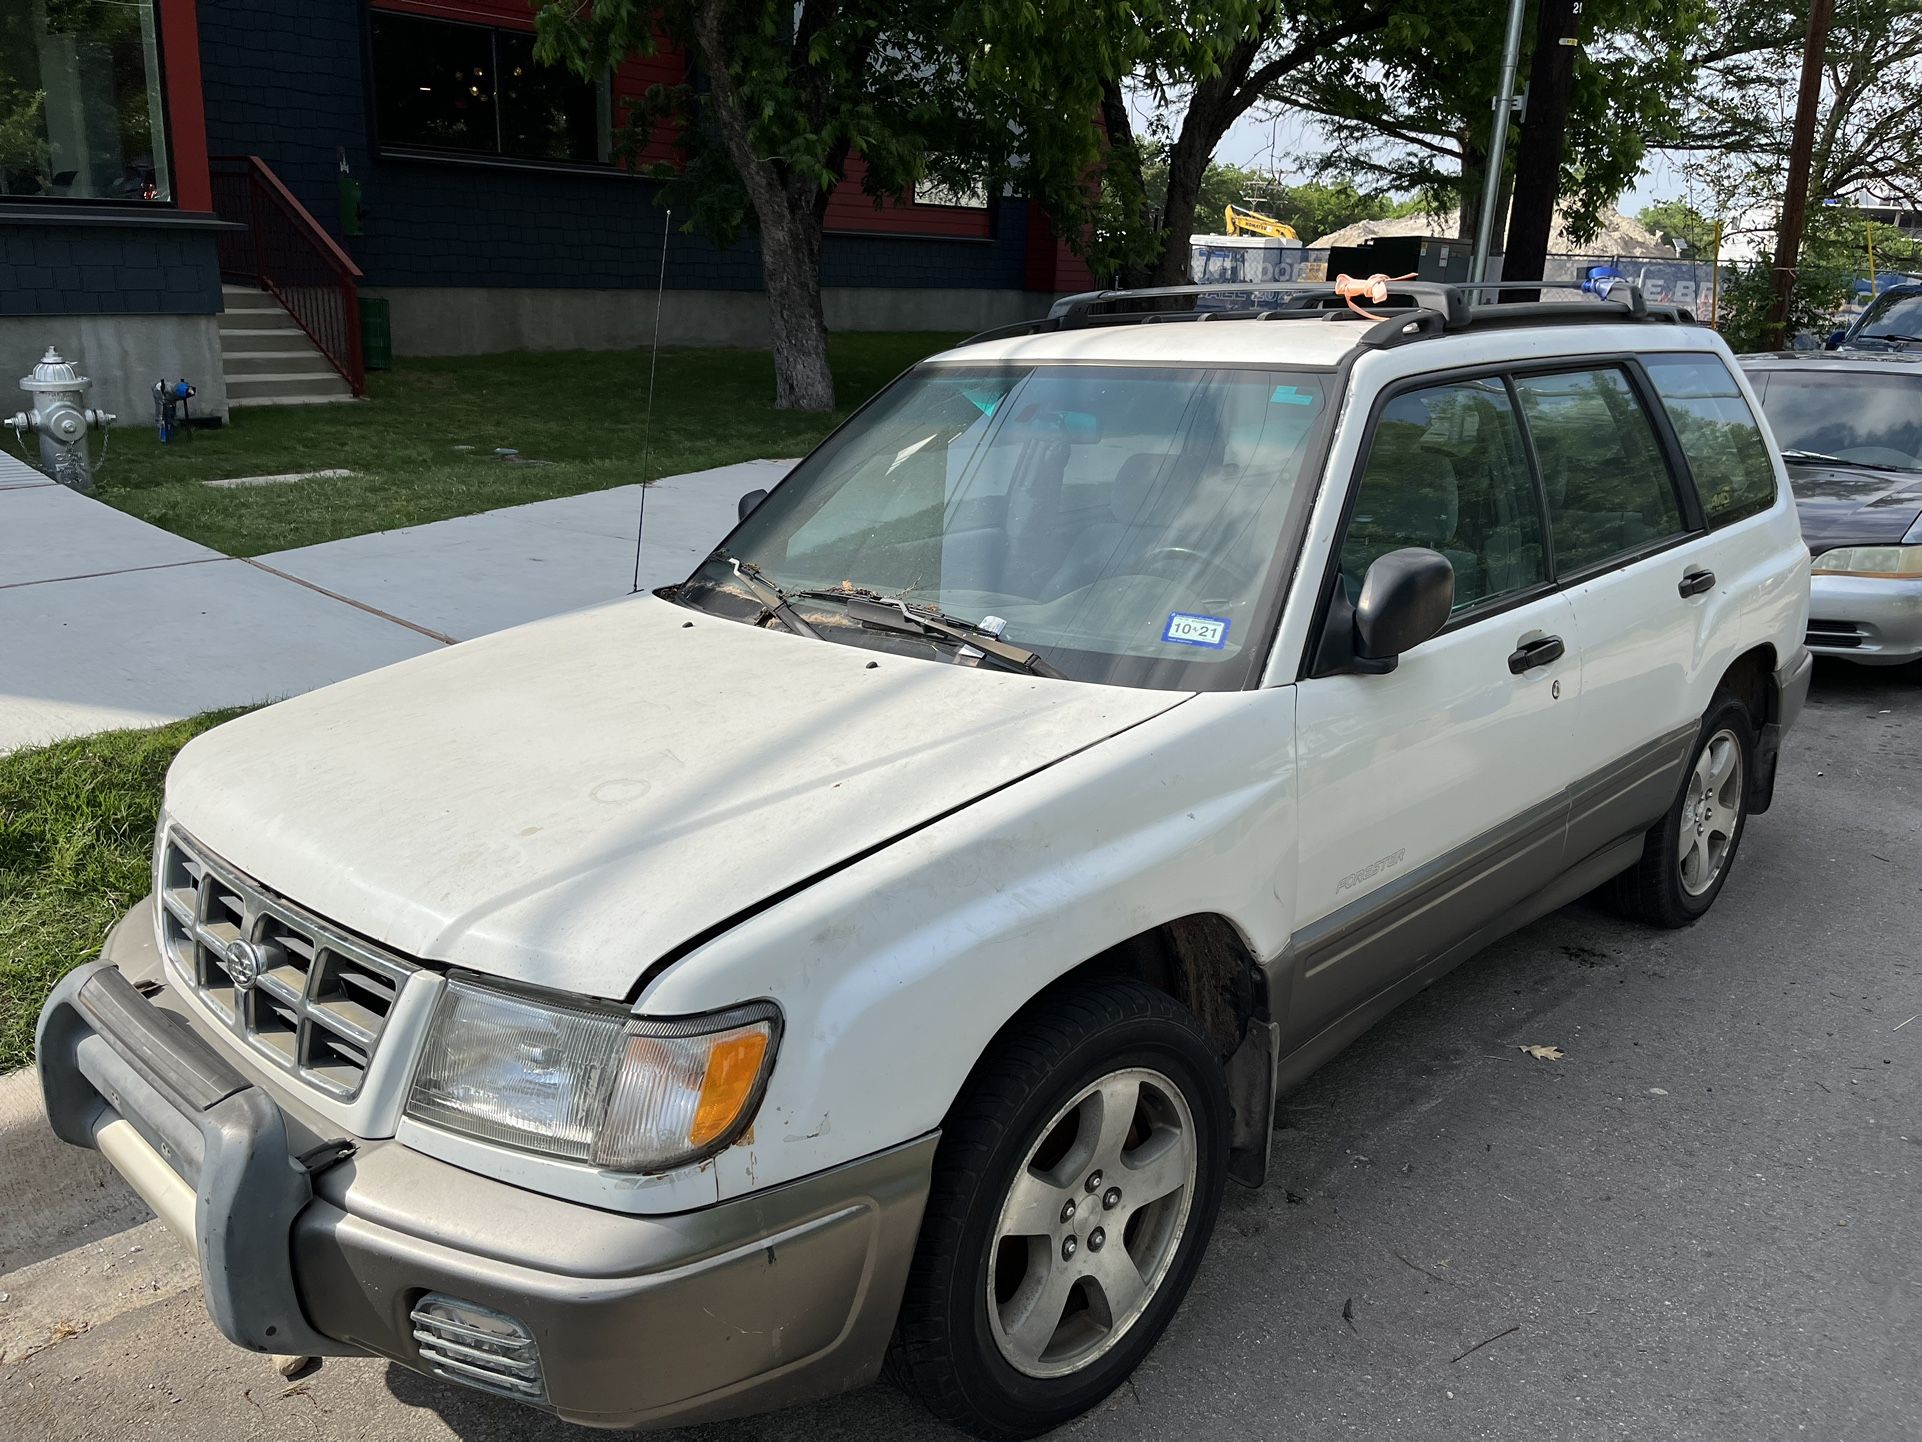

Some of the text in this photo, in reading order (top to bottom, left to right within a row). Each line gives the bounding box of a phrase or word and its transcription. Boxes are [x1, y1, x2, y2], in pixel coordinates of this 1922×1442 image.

[1572, 2, 1583, 14] 21
[1245, 220, 1267, 231] KOMATSU
[1335, 848, 1405, 895] FORESTER
